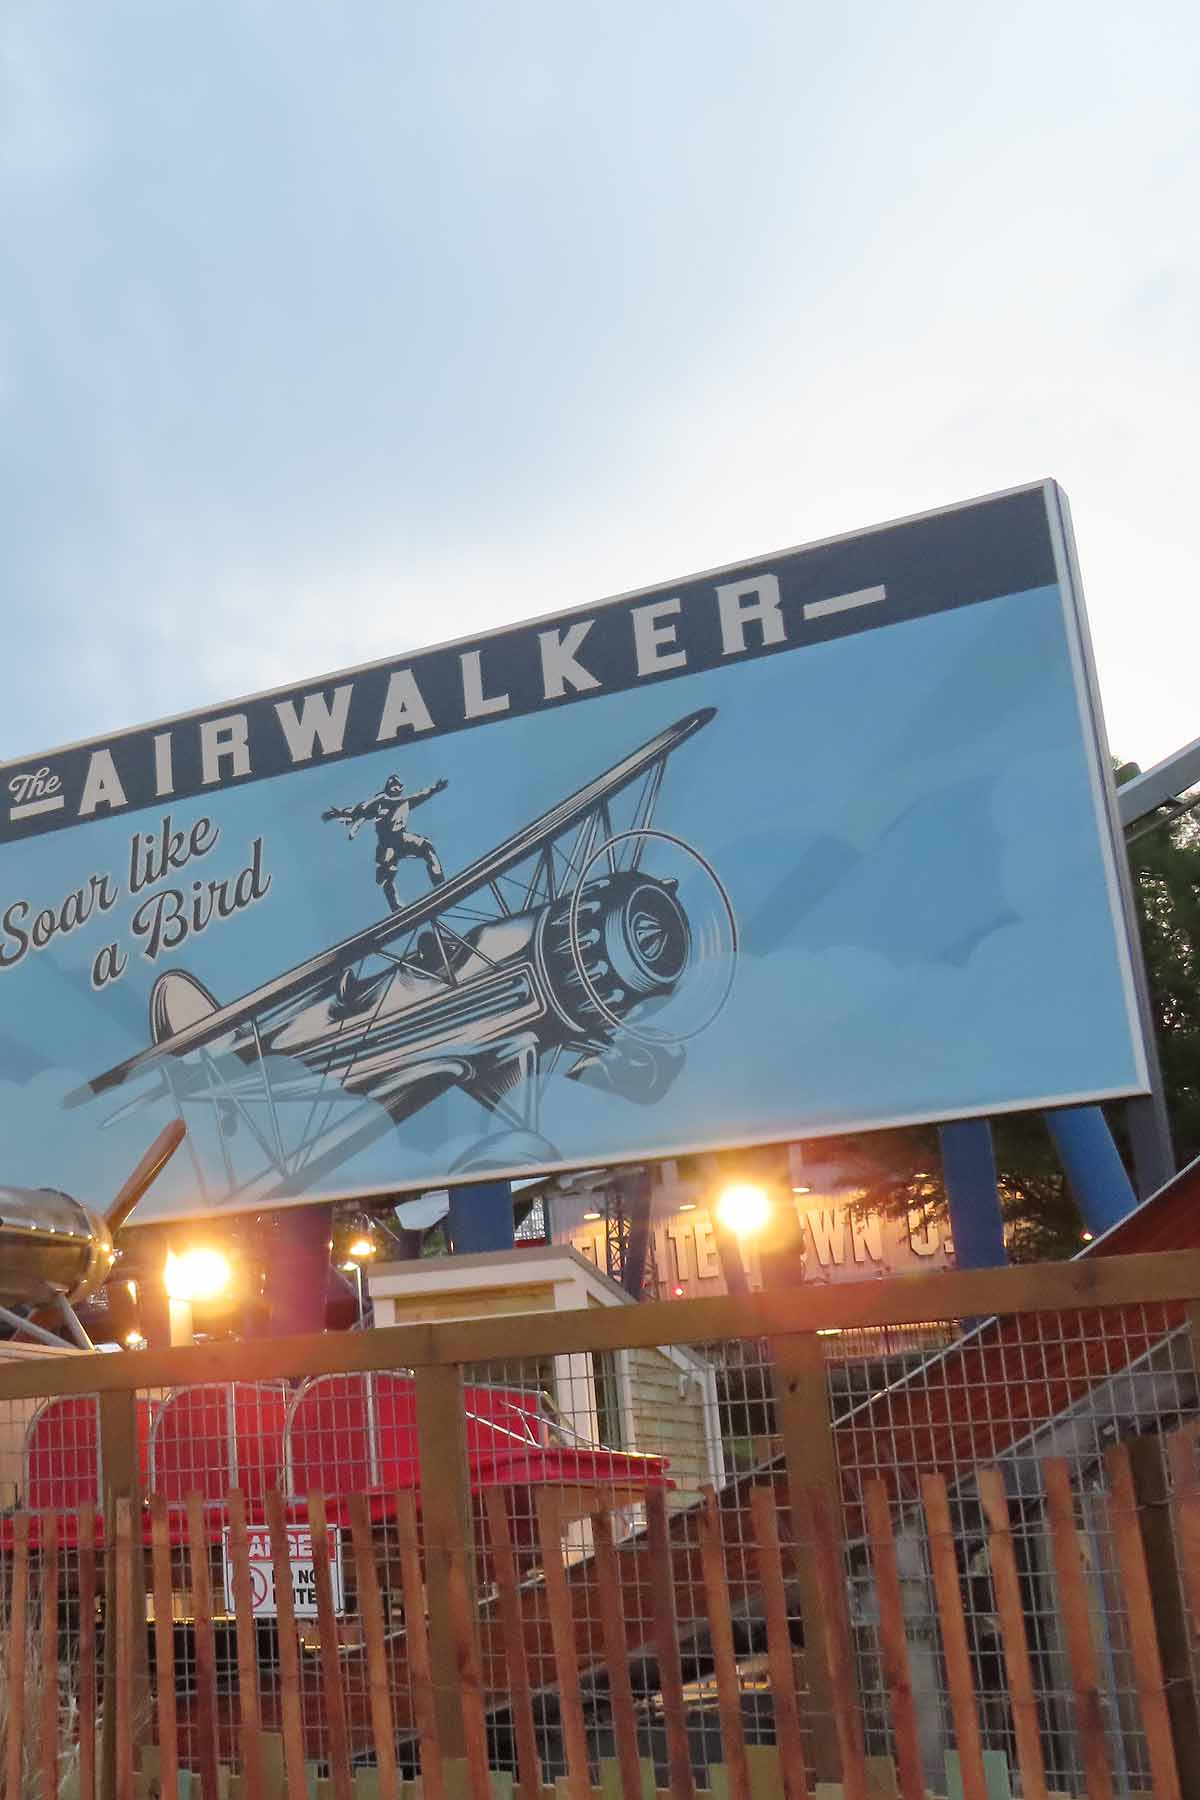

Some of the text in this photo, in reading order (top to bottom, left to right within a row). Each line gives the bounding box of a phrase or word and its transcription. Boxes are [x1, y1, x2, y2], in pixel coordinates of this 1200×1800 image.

[8, 574, 787, 815] The AIRWALKER
[92, 837, 272, 987] a Bird
[129, 815, 220, 893] like
